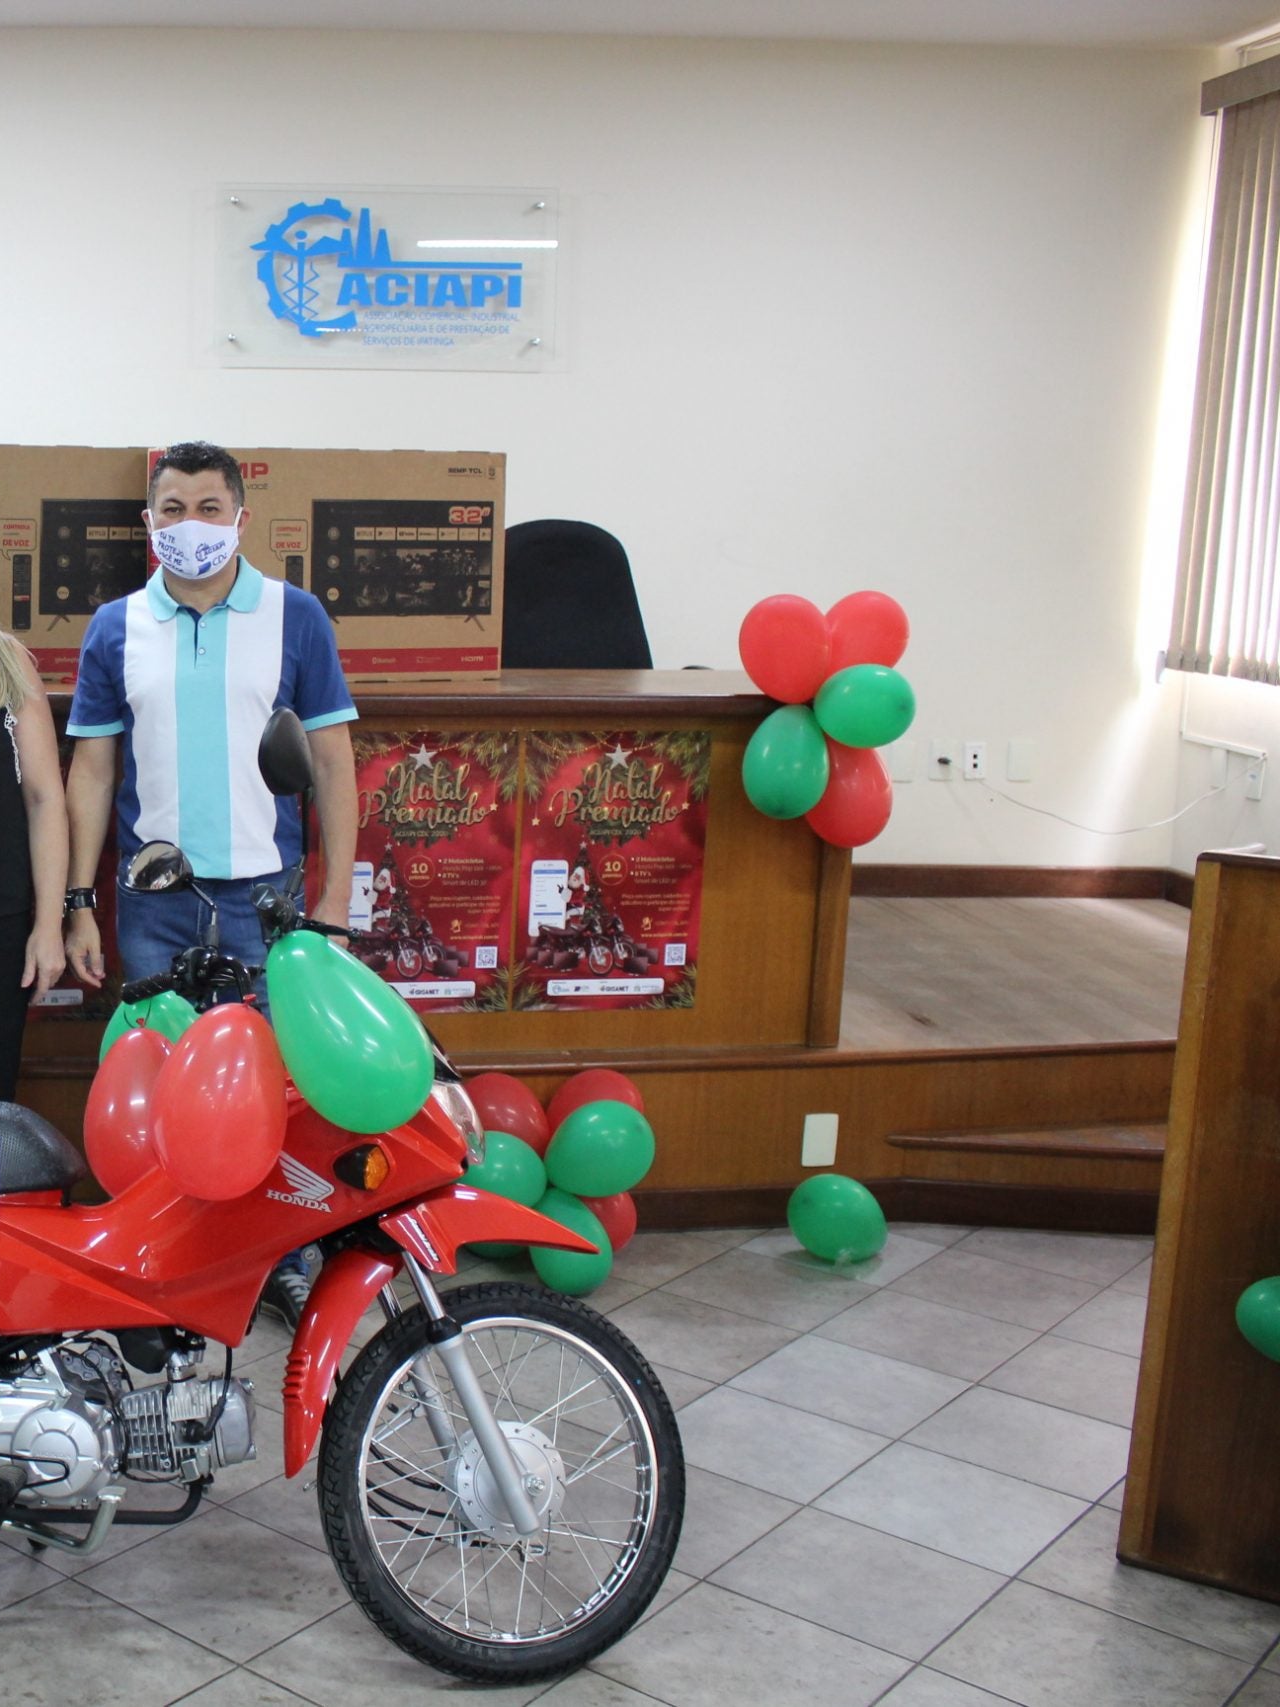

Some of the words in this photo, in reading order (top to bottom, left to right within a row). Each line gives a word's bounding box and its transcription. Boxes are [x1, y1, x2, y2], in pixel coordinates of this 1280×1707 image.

[337, 273, 522, 308] ACIAPI
[387, 761, 470, 804] Natal
[584, 762, 664, 803] Natal
[359, 791, 488, 829] Premiado
[554, 789, 682, 828] Premiado
[411, 862, 429, 874] 10
[604, 860, 622, 872] 10
[414, 988, 440, 996] GIGANET
[605, 985, 629, 993] GIGANET
[266, 1189, 332, 1214] HONDA
